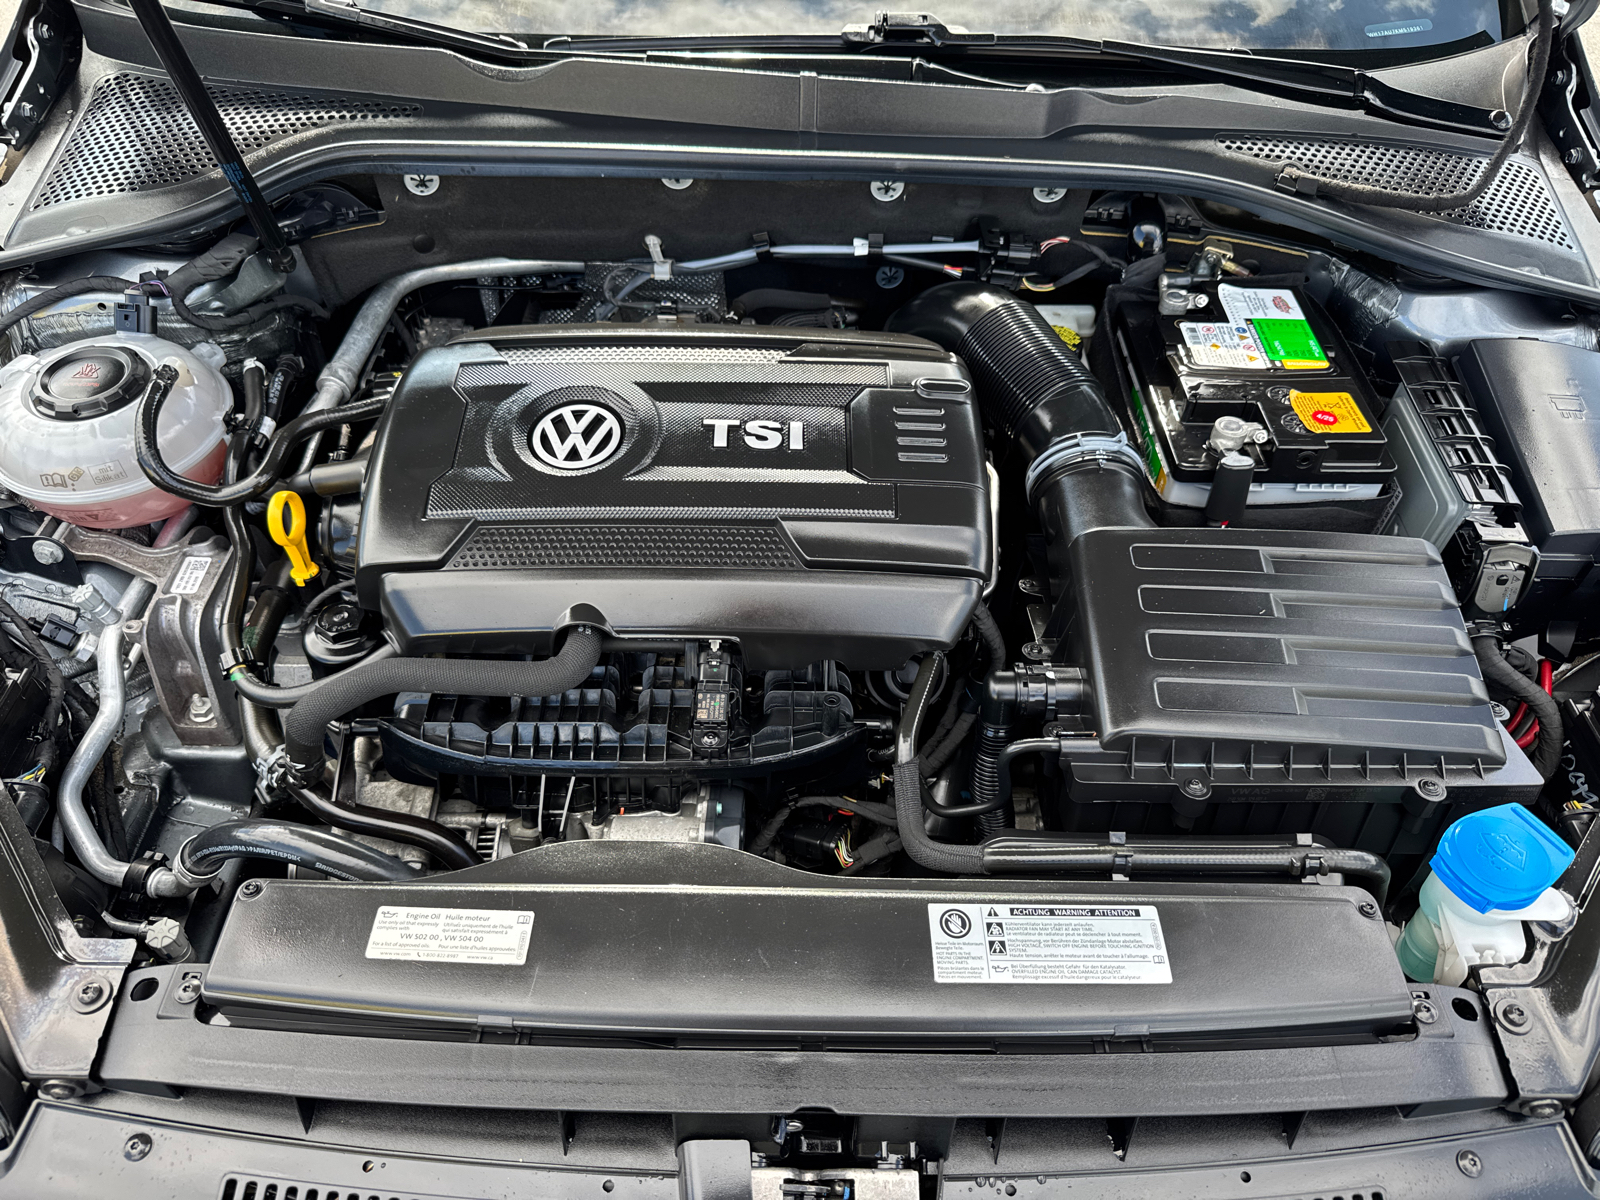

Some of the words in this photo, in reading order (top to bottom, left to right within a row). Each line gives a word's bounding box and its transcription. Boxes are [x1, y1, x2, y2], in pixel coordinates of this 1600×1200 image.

[1316, 413, 1335, 422] 4/25
[703, 419, 804, 450] TSI
[98, 464, 114, 474] mit
[95, 471, 125, 484] Silikat
[406, 912, 430, 920] Engine
